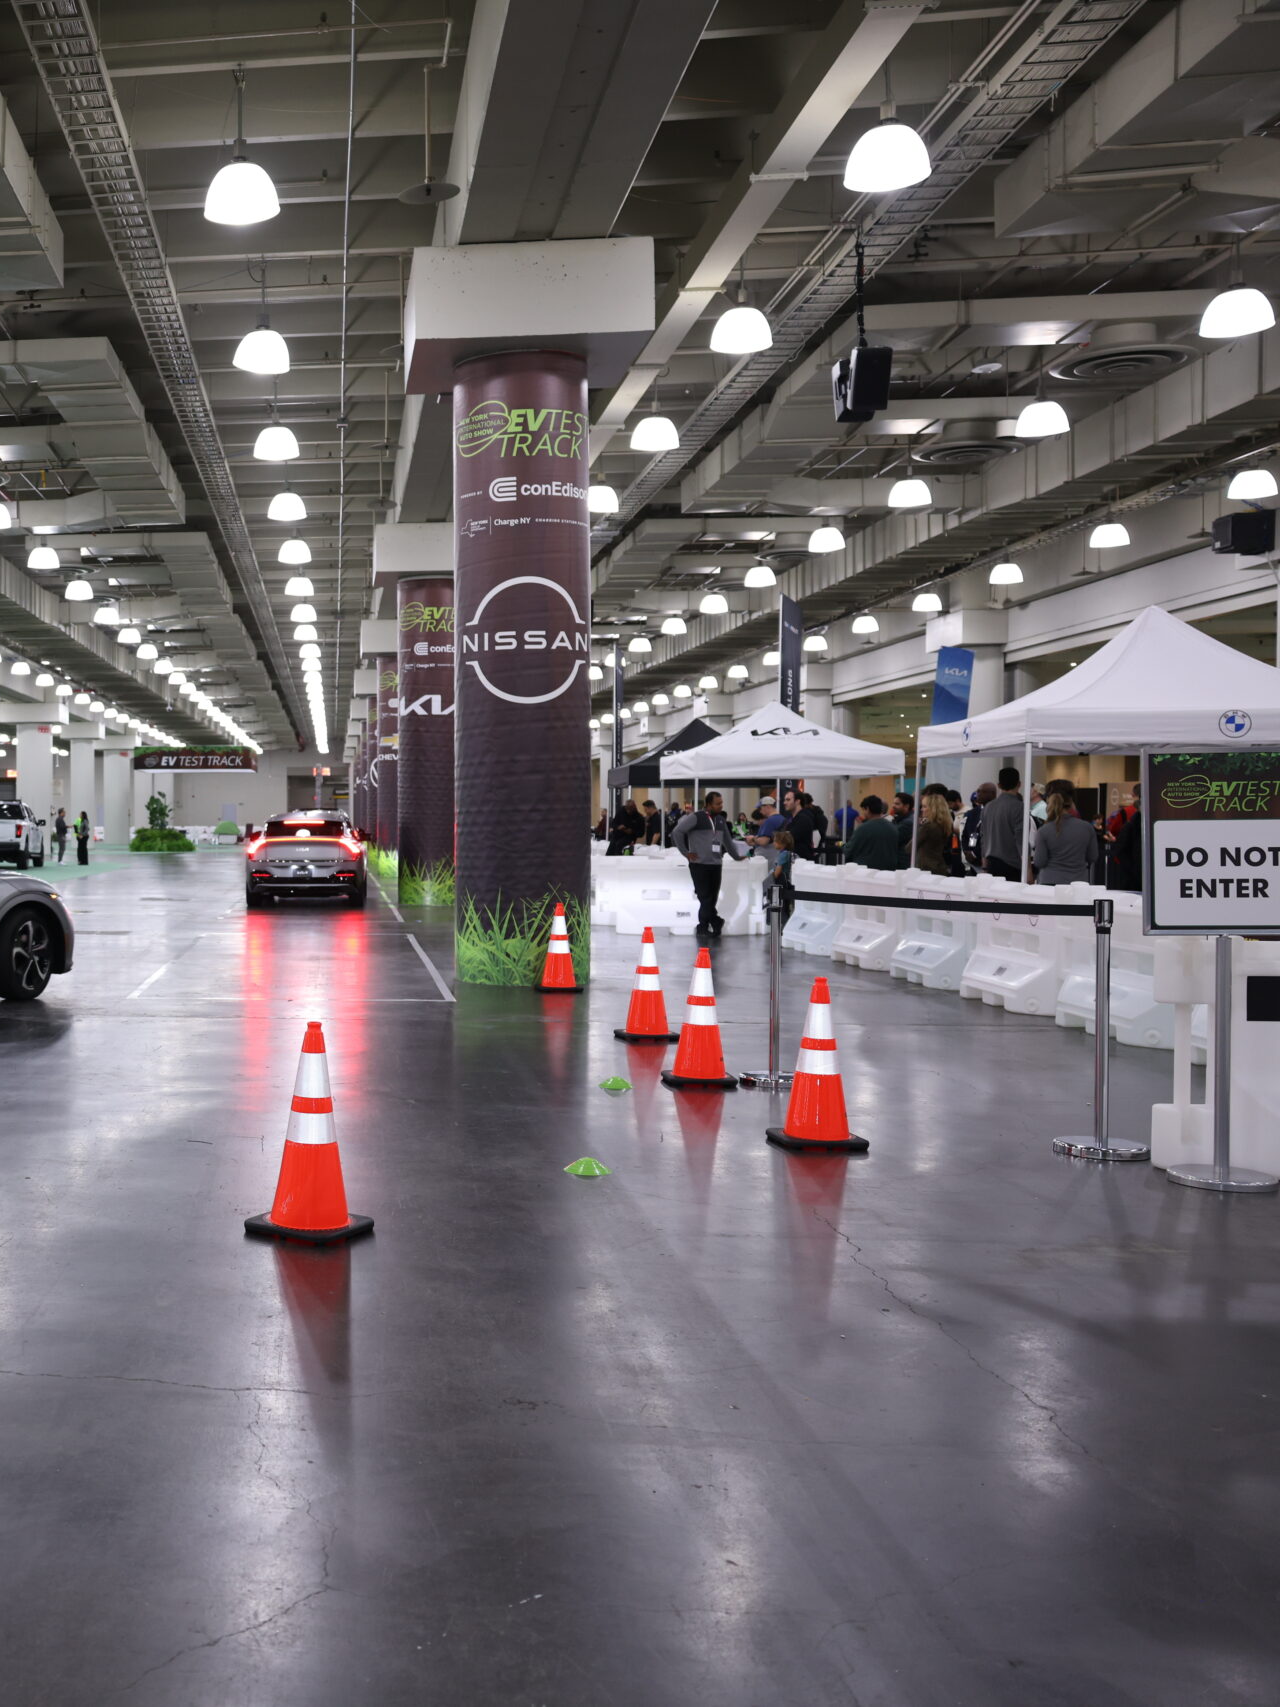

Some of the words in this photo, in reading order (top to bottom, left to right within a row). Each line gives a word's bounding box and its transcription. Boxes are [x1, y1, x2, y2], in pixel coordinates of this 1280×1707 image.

[472, 413, 489, 422] YORK
[474, 428, 494, 439] SHOW
[497, 433, 583, 459] TRACK
[494, 518, 519, 527] Charge
[418, 619, 455, 633] TRAC
[463, 630, 588, 653] NISSAN
[161, 755, 178, 766] EV
[179, 755, 205, 767] TEST
[205, 755, 244, 766] TRACK
[1202, 796, 1271, 812] TRACK
[1165, 847, 1209, 867] DO
[1220, 846, 1280, 867] NOT
[1180, 878, 1270, 898] ENTER
